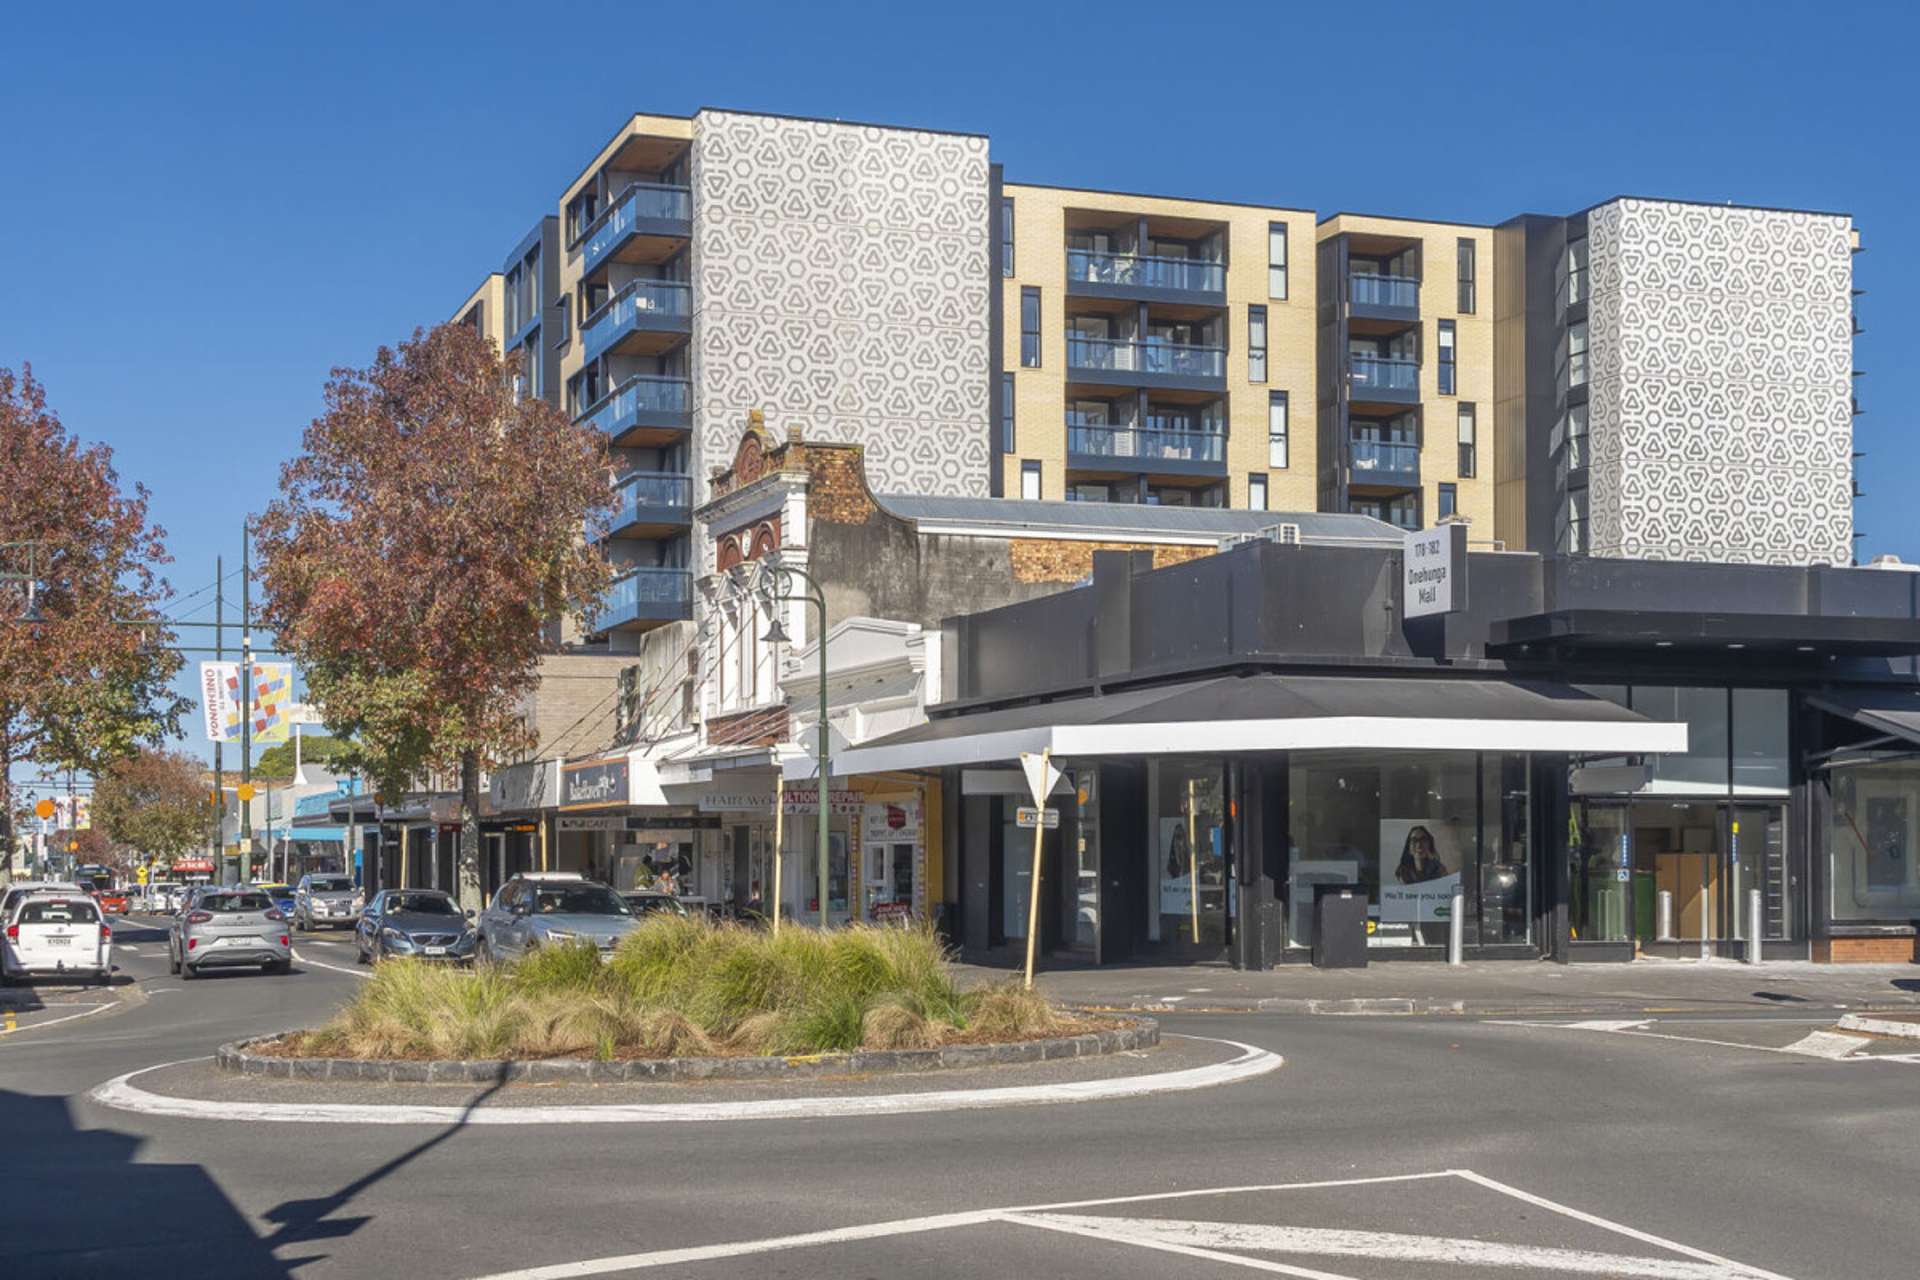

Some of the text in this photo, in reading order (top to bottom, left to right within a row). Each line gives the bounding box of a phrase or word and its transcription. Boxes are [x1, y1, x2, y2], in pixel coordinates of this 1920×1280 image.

[1408, 567, 1446, 584] Onehunga
[1418, 586, 1436, 605] Mall
[204, 669, 219, 737] ONEHUNGA
[1420, 893, 1436, 901] you
